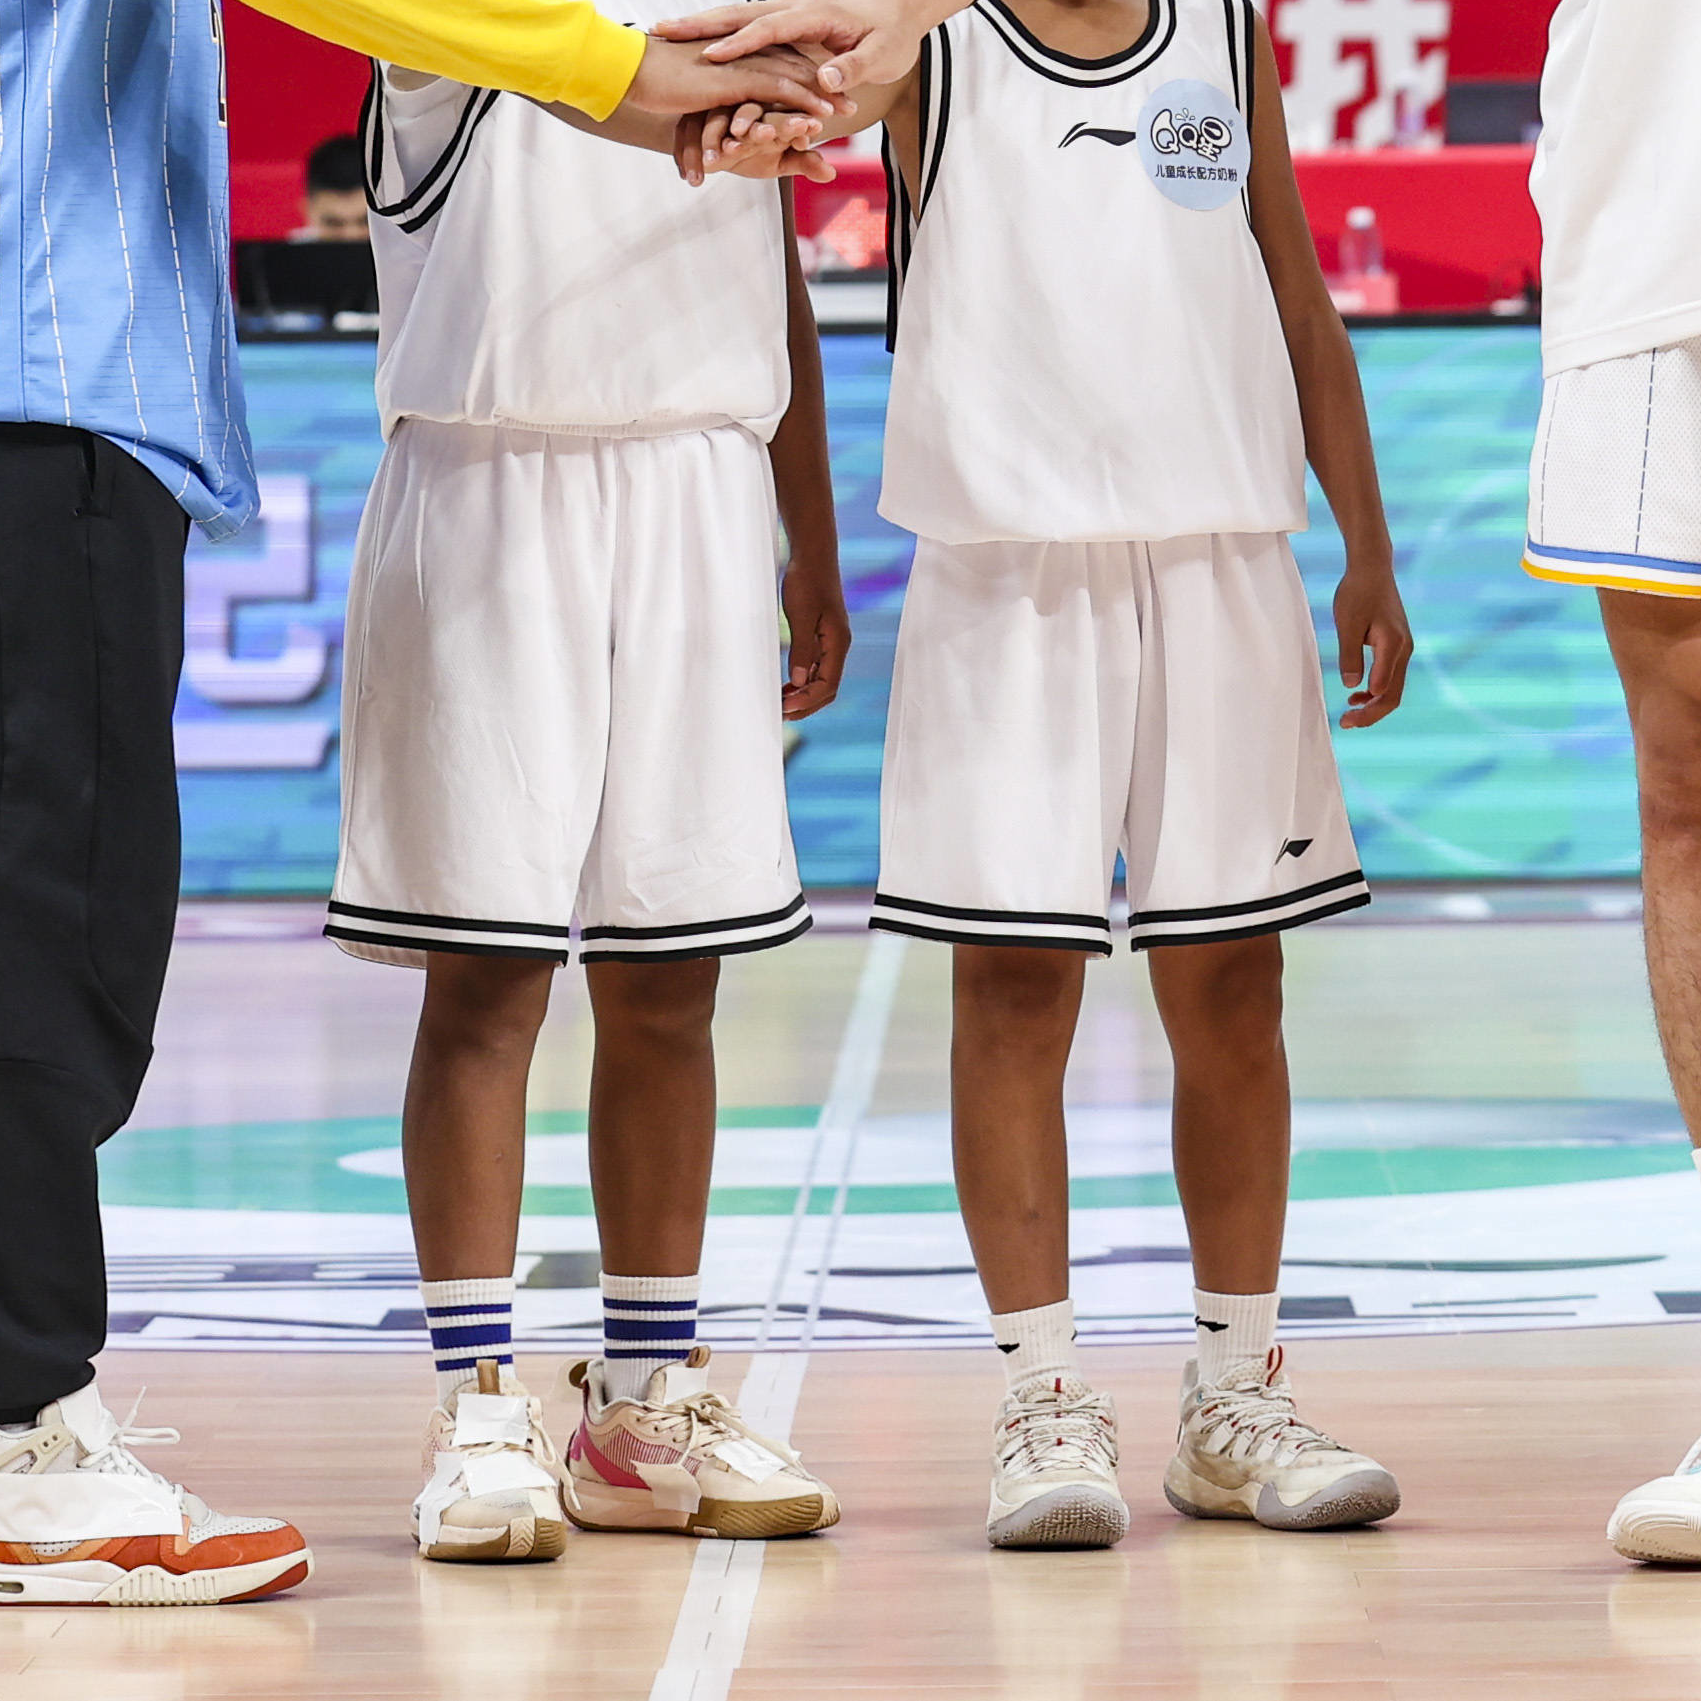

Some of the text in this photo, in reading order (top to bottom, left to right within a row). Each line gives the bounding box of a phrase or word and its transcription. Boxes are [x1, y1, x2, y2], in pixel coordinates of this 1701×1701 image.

[1155, 163, 1238, 182] 儿童成长配方奶粉
